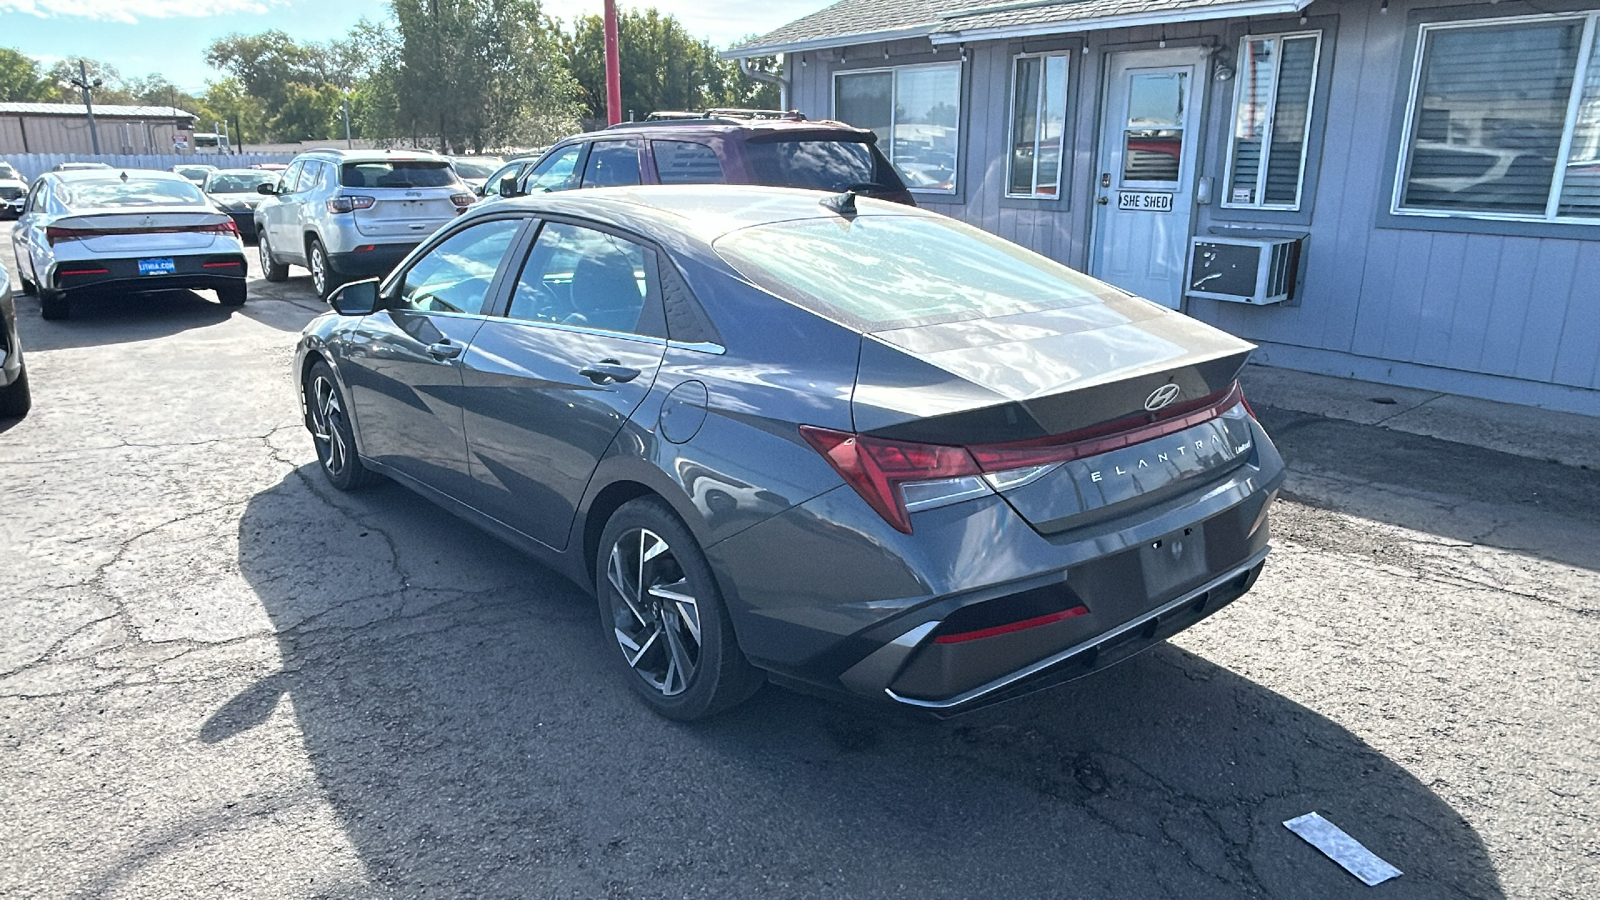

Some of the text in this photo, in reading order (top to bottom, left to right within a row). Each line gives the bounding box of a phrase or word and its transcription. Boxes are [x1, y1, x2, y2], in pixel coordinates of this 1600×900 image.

[1122, 194, 1168, 208] SHE SHED
[1091, 434, 1219, 482] ELANTRA
